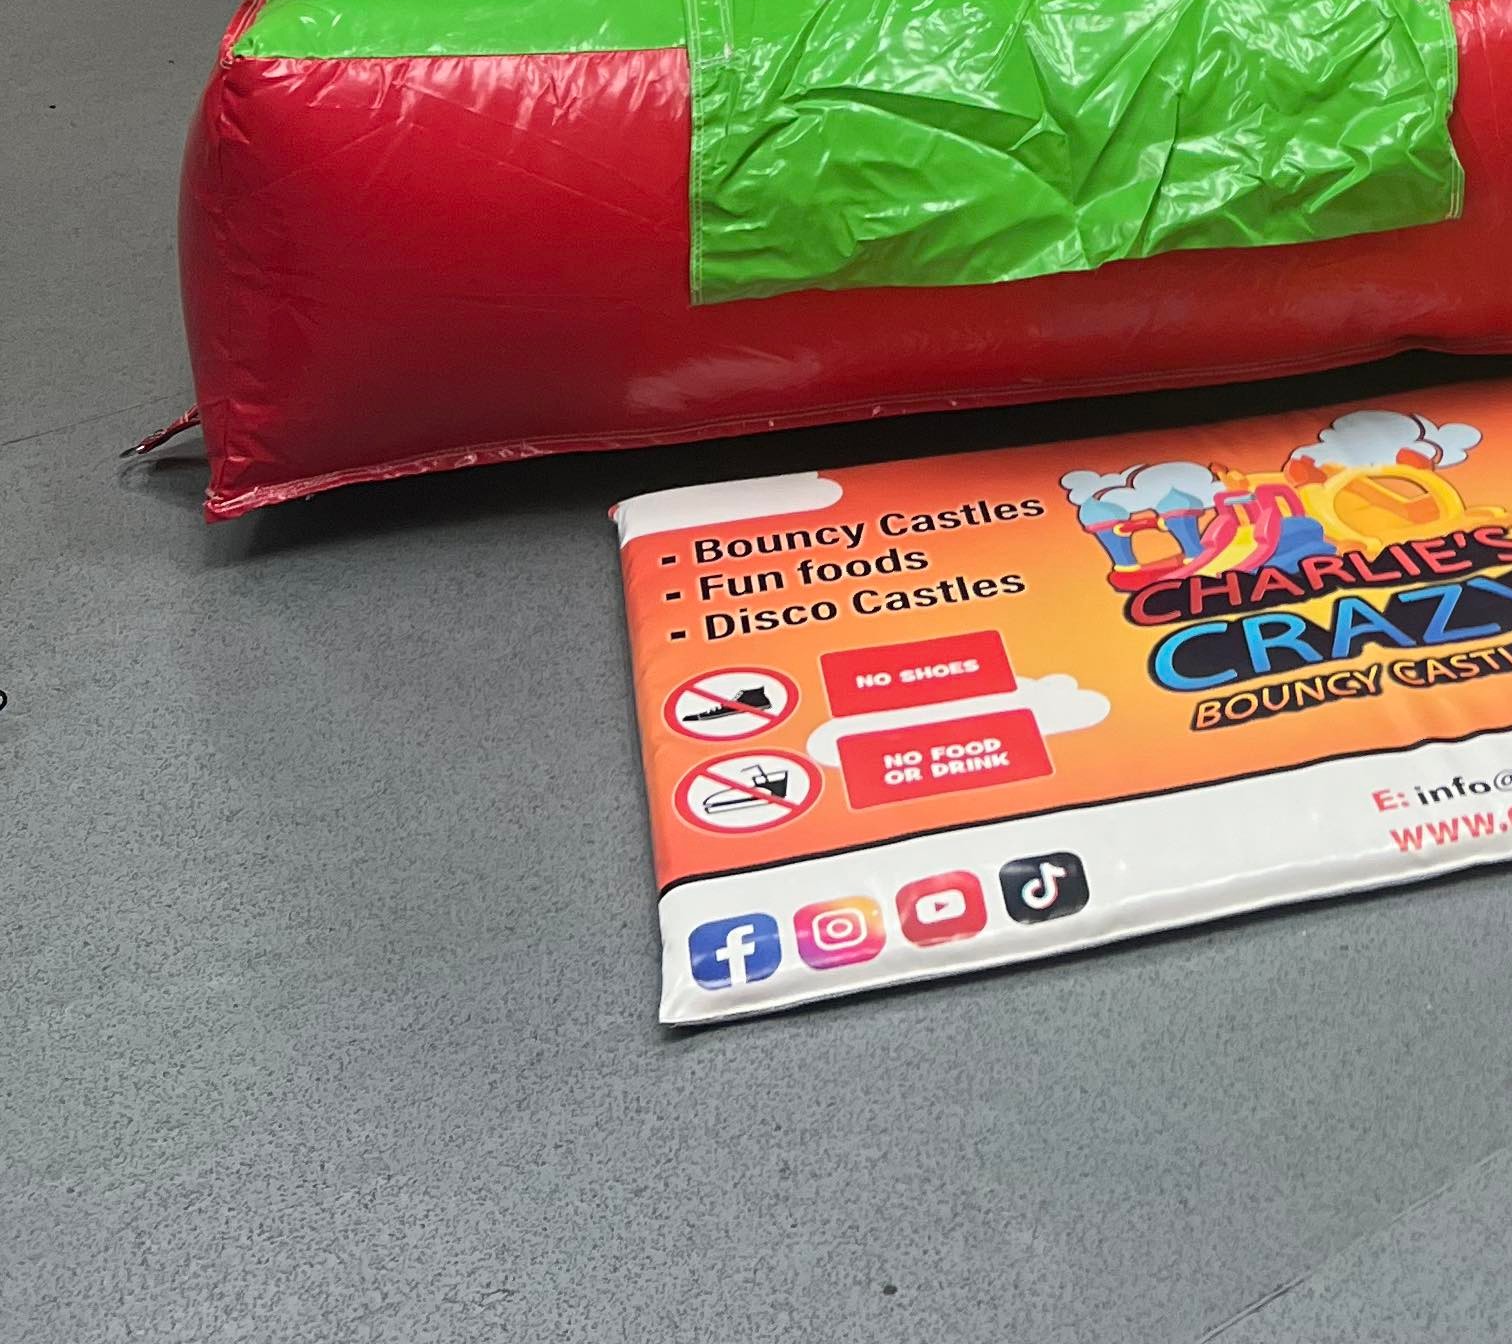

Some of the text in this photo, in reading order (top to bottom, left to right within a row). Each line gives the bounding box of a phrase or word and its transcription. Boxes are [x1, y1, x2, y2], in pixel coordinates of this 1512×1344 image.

[695, 522, 864, 564] Bouncy
[880, 498, 1045, 537] Castles
[699, 567, 784, 600] Fun
[798, 548, 929, 585] foods
[705, 601, 838, 640] Disco
[852, 573, 1026, 615] Castles
[856, 660, 980, 688] NO SHOES
[1196, 664, 1381, 729] BOUNCY
[884, 738, 1001, 768] NO FOOD
[885, 752, 1010, 785] OR DRINK
[1372, 789, 1410, 812] E:
